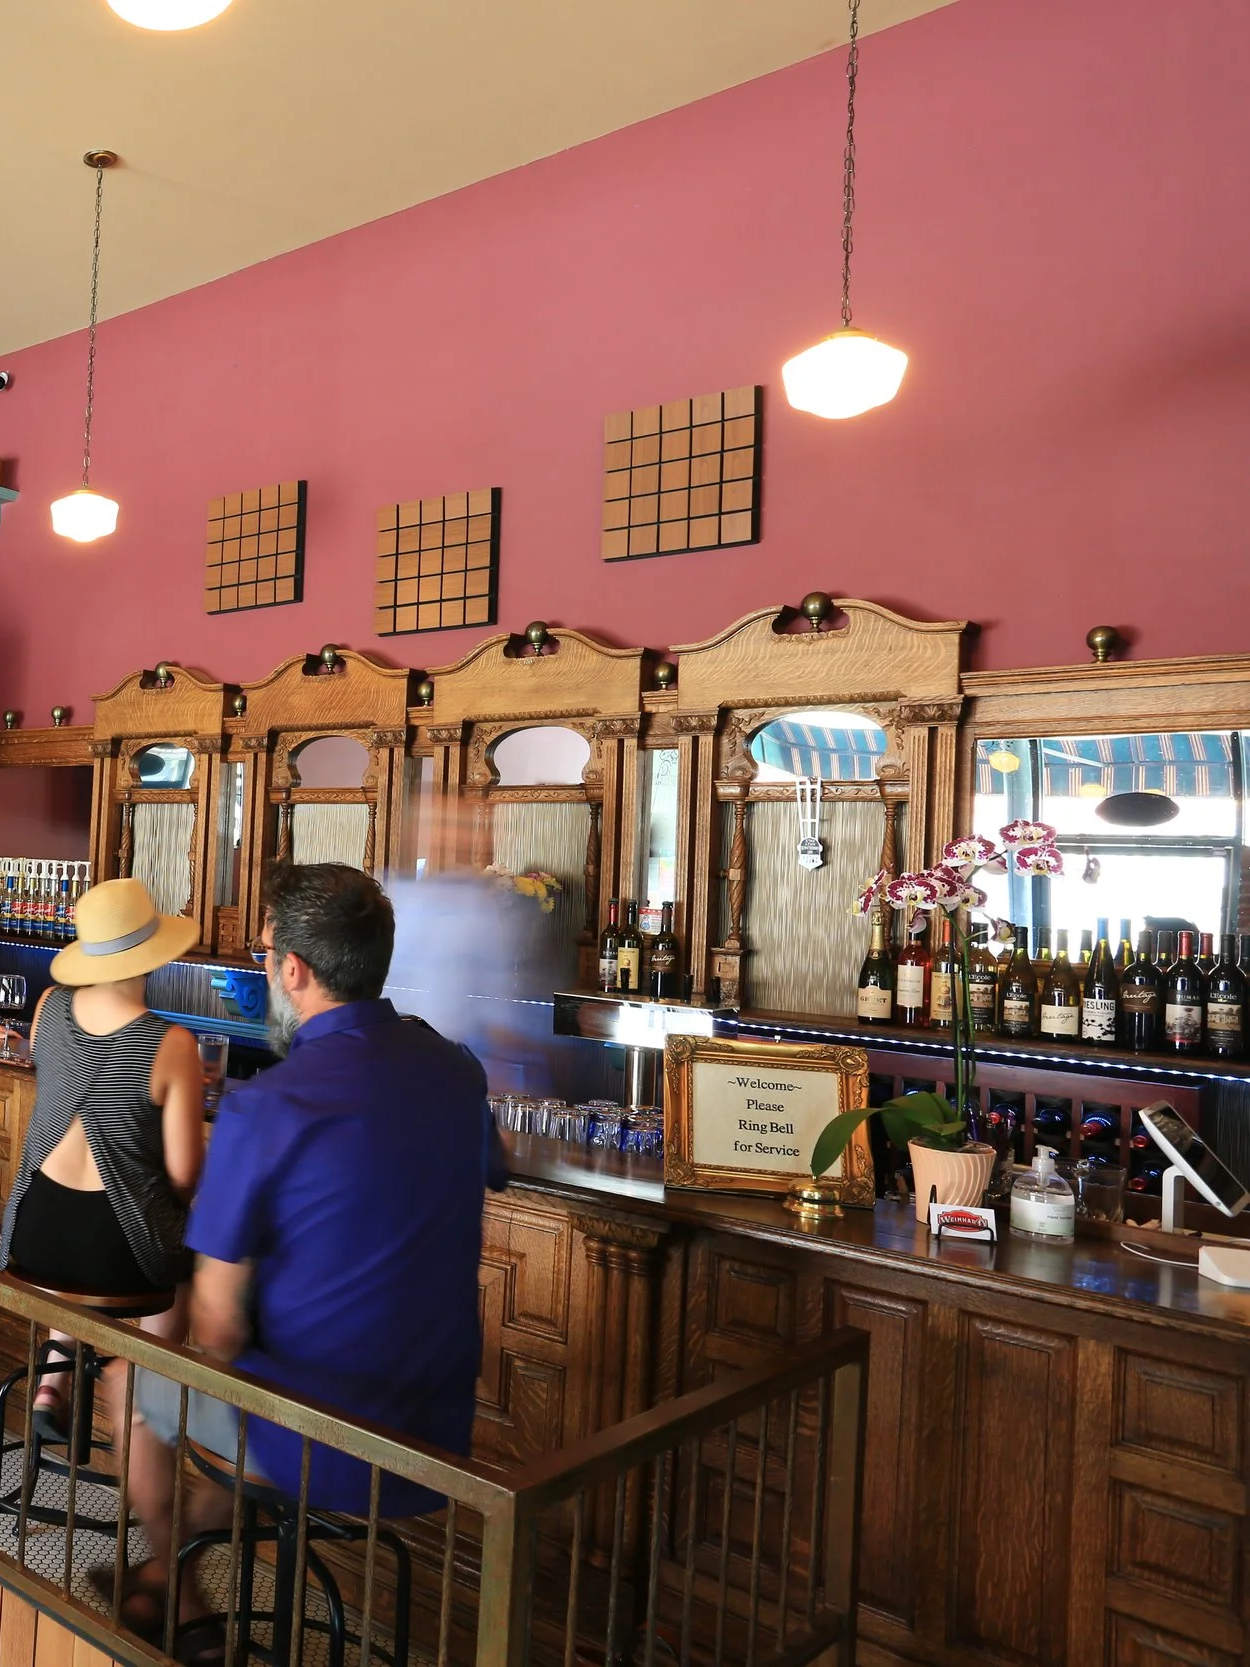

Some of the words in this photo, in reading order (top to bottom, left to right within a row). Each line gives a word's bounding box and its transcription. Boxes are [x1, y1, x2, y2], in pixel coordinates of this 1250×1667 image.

[1083, 1000, 1115, 1012] IESLING
[746, 1098, 785, 1112] Please
[738, 1119, 768, 1135] Ring
[769, 1122, 794, 1135] Bell
[734, 1140, 753, 1153] for
[755, 1142, 800, 1157] Service
